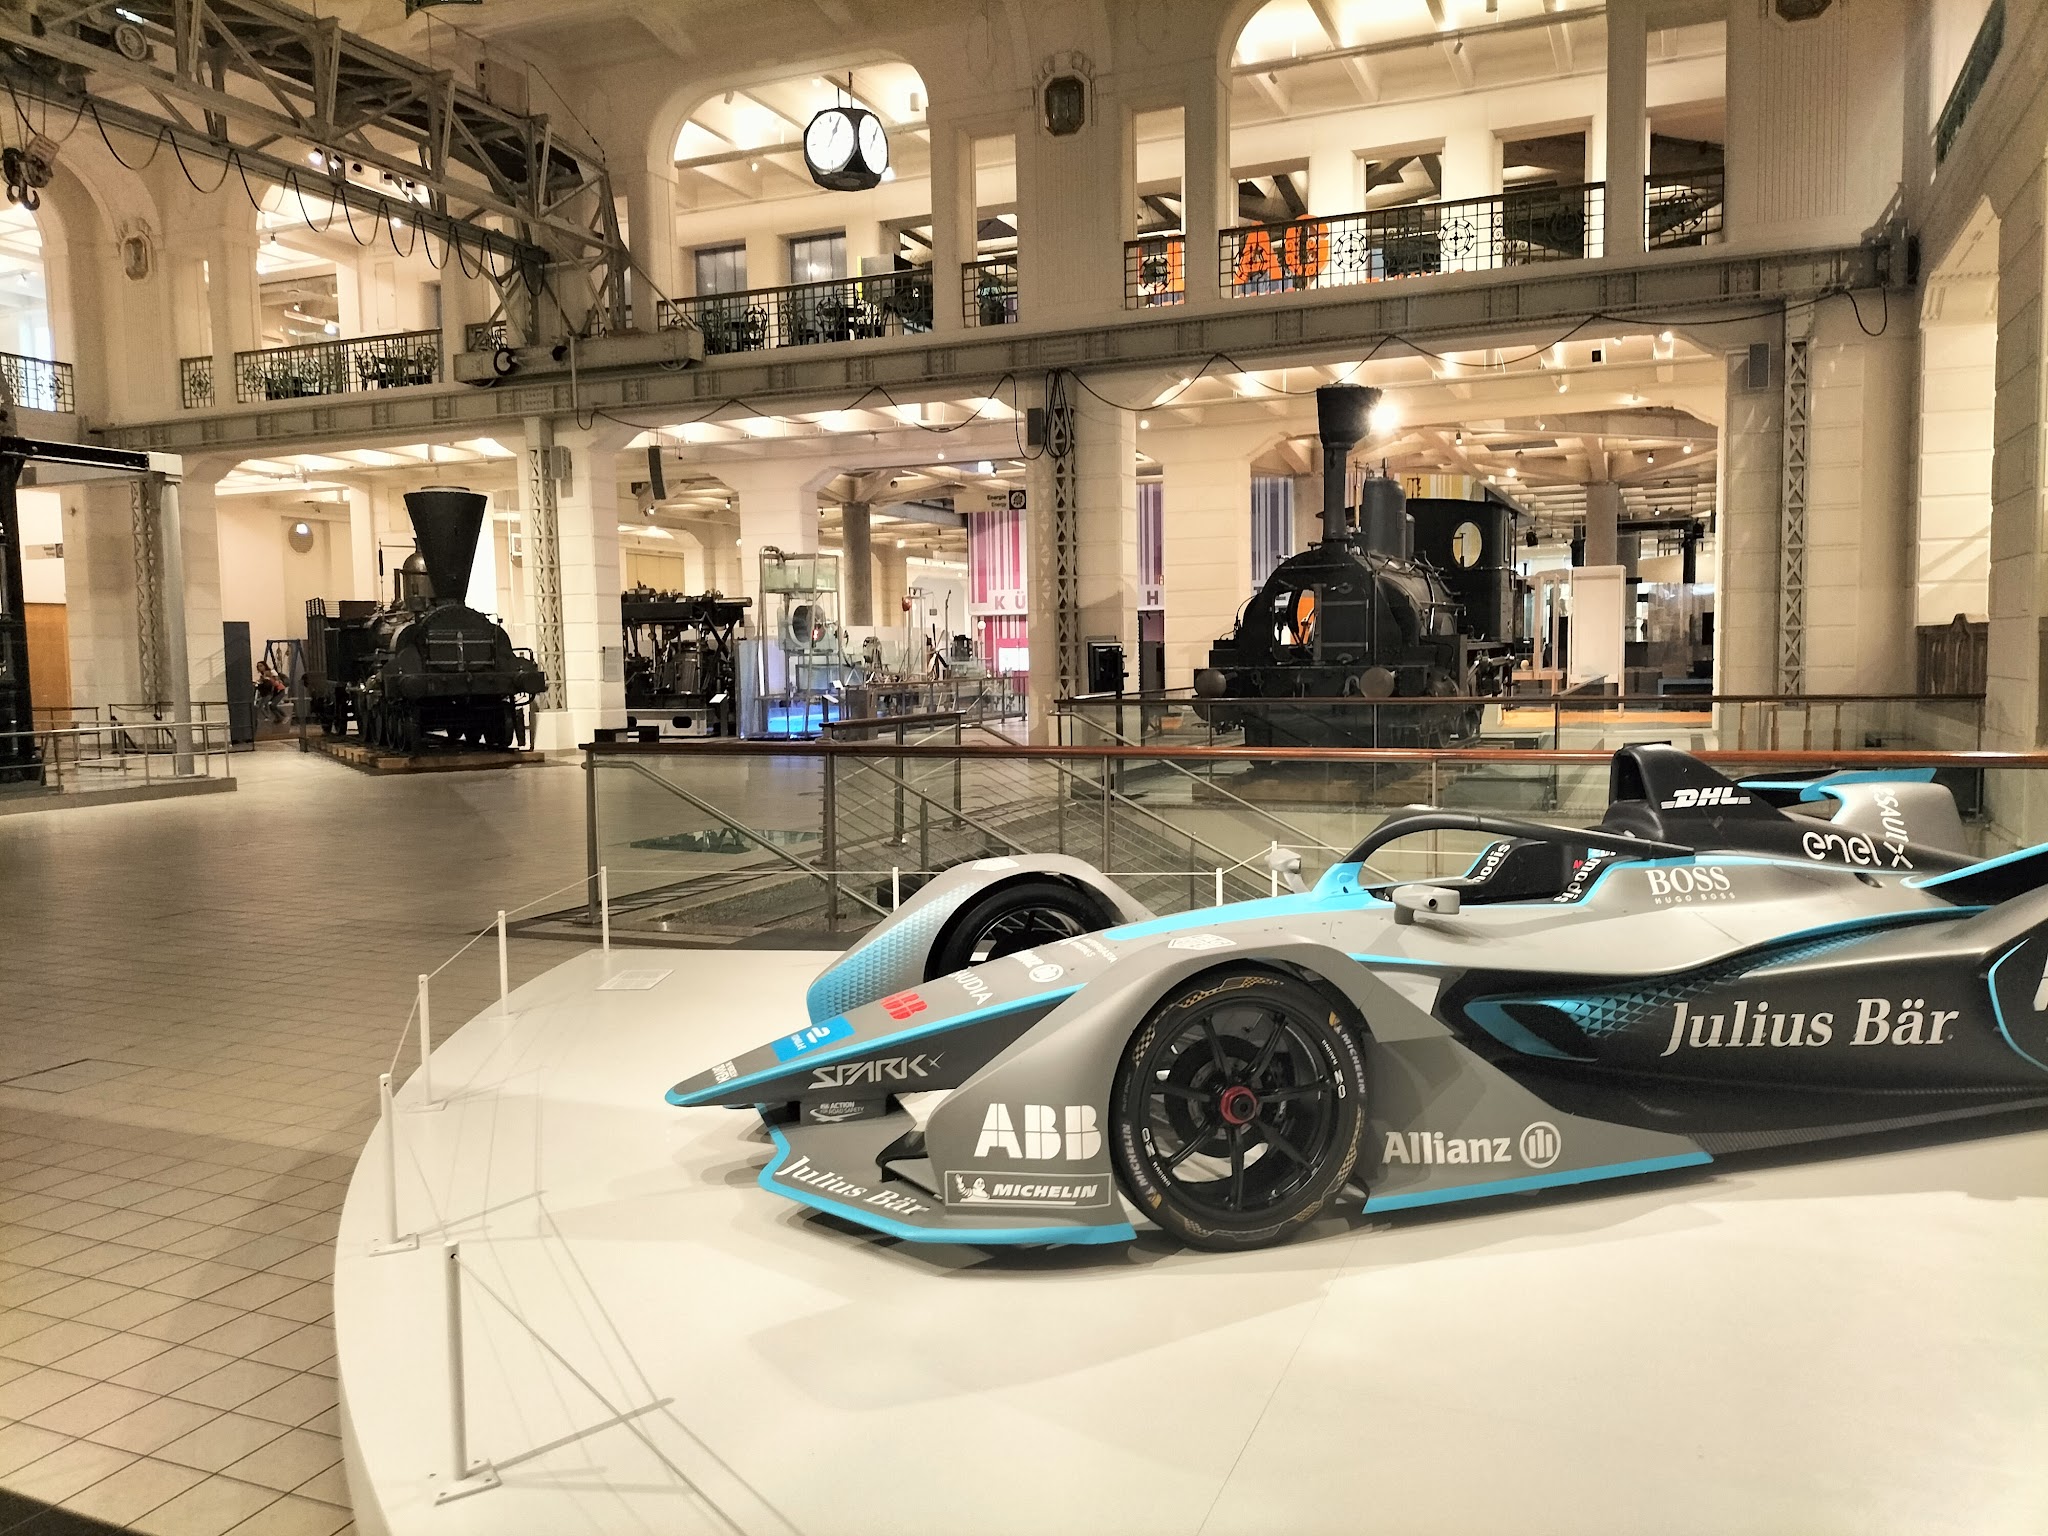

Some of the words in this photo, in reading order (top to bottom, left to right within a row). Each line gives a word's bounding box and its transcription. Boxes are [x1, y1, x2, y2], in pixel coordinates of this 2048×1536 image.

[1668, 786, 1747, 809] DHL
[1645, 866, 1731, 896] BOSS
[1654, 895, 1692, 905] HUGO
[1701, 891, 1736, 900] BOSS
[1660, 1000, 1834, 1057] Julius
[1849, 998, 1960, 1046] Bär
[808, 1053, 929, 1090] SPARK
[1341, 1033, 1365, 1093] MICHELIN
[830, 1101, 855, 1109] ACTION
[974, 1103, 1102, 1160] ABB
[1382, 1131, 1512, 1165] Allianz
[1122, 1123, 1148, 1187] MICHELIN
[775, 1155, 867, 1197] Julius
[863, 1189, 930, 1216] Bär
[992, 1183, 1099, 1199] MICHELIN
